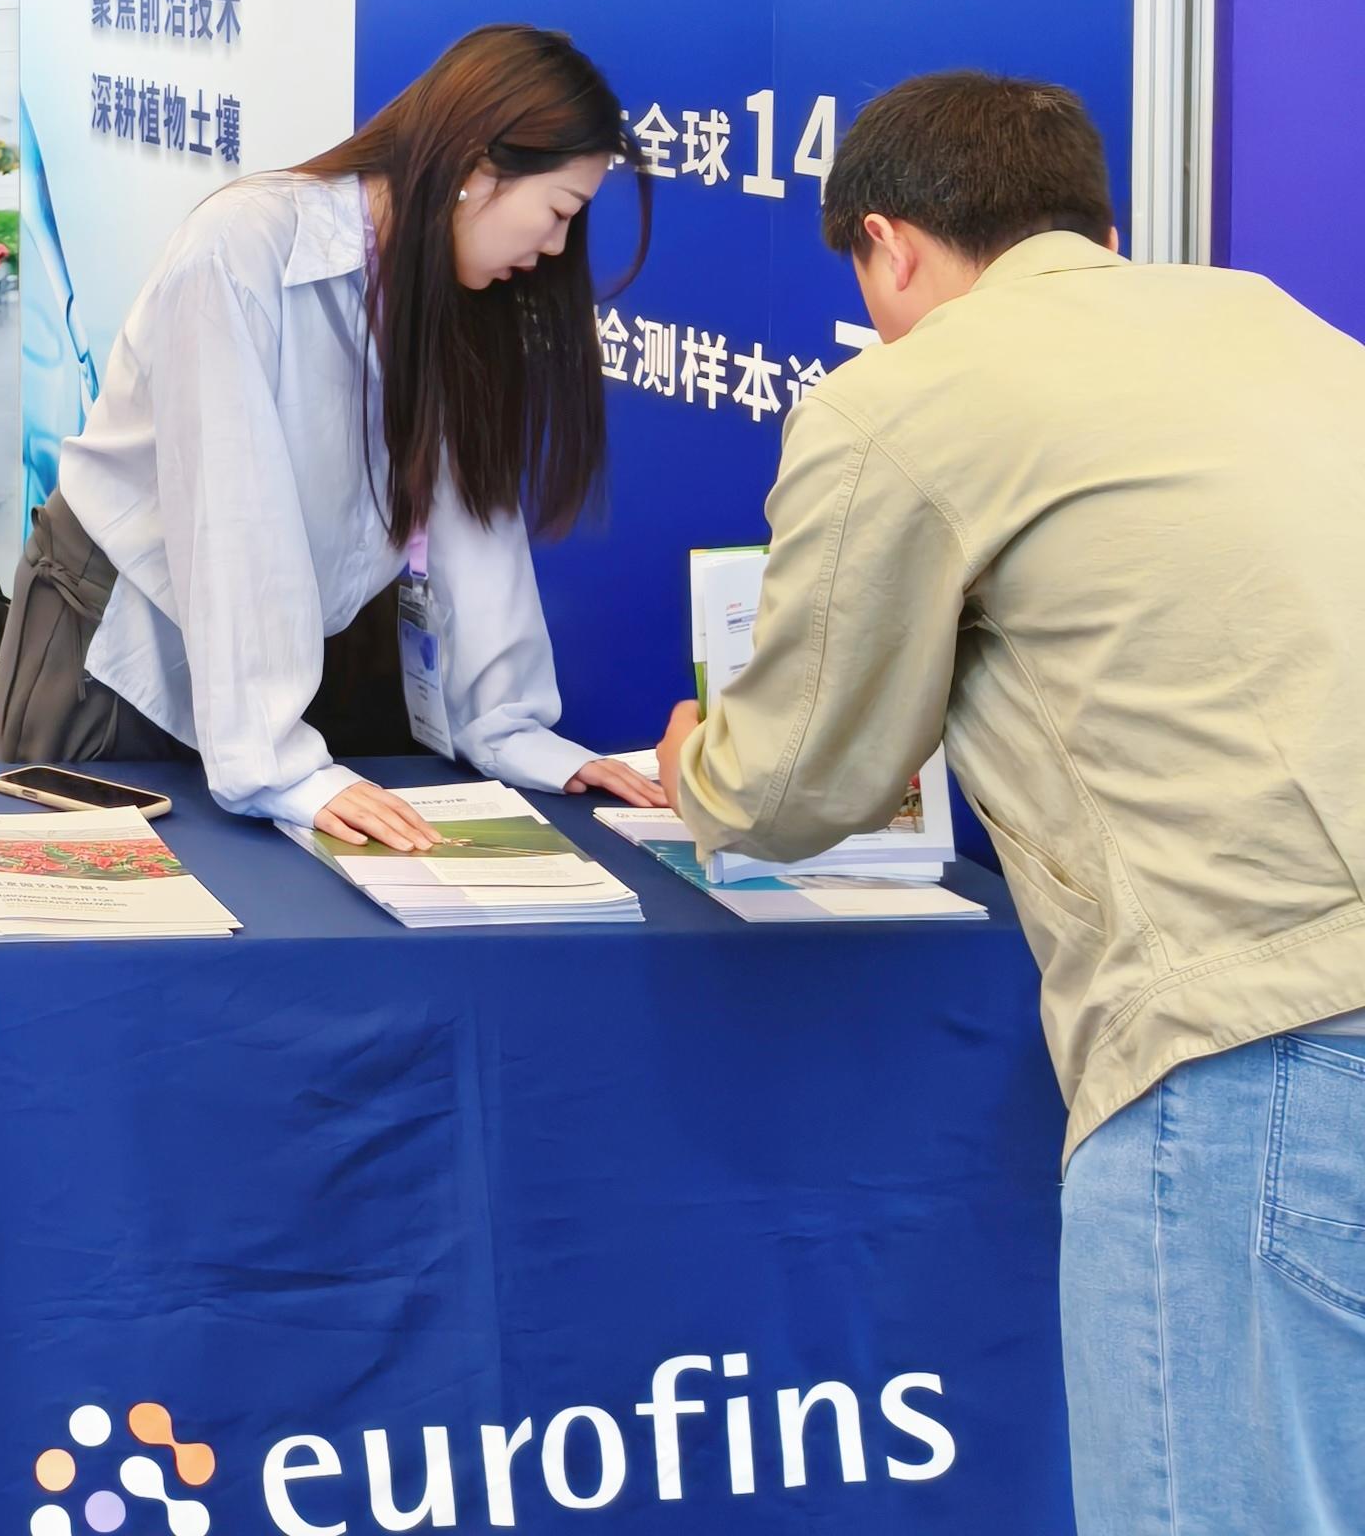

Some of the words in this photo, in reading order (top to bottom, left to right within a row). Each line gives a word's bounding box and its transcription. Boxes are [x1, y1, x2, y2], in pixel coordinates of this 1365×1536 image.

[90, 72, 243, 166] 深耕植物土壤
[608, 88, 836, 206] 全球14
[262, 1351, 957, 1536] eurofins
